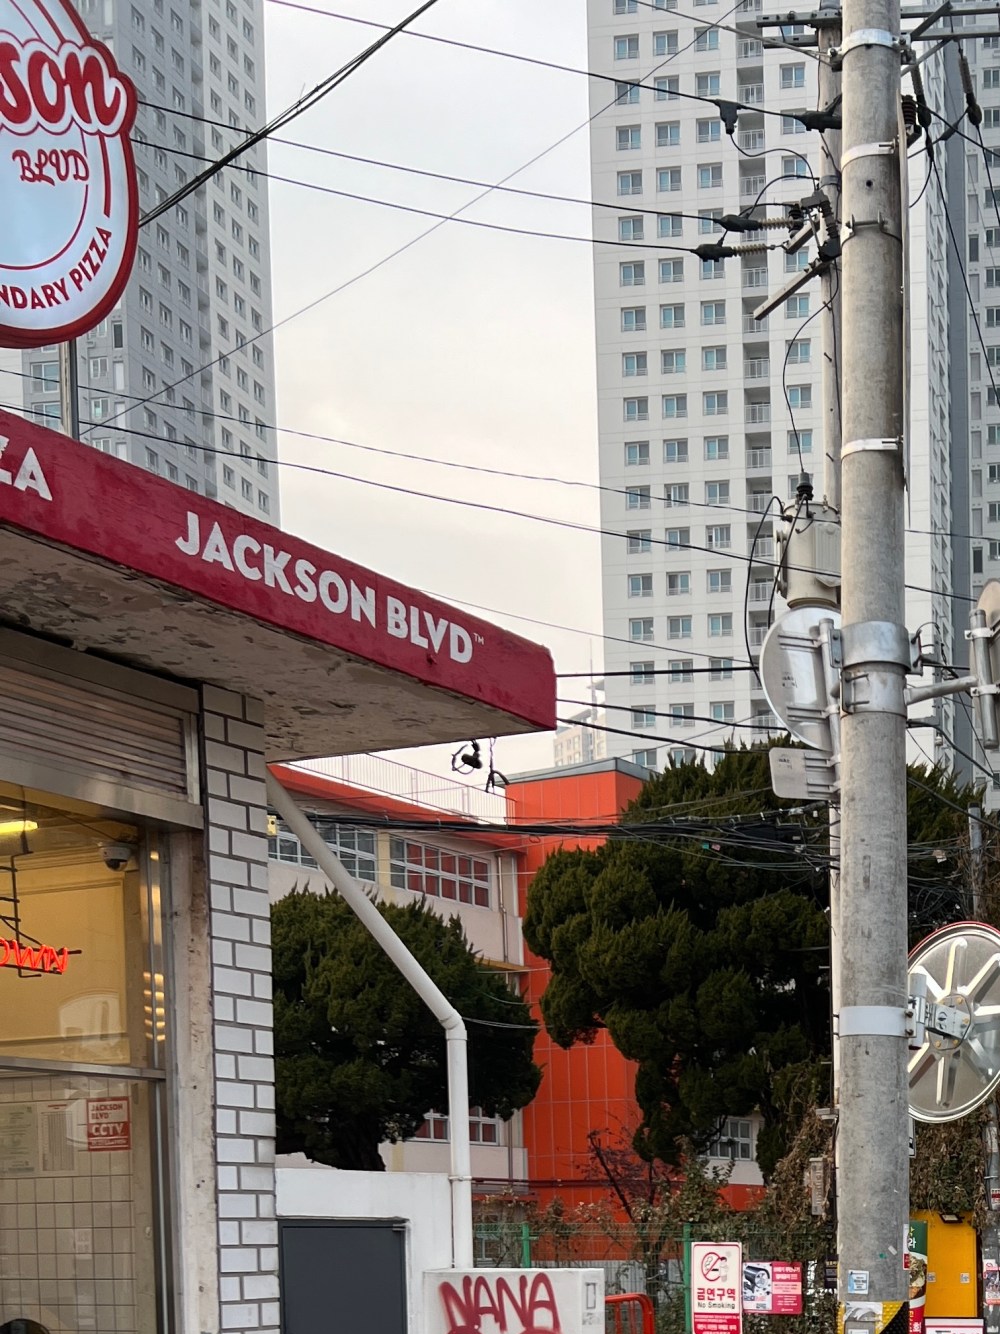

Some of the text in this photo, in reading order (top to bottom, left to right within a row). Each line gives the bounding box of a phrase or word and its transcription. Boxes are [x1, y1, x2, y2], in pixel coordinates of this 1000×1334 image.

[12, 148, 89, 186] BLVD
[69, 226, 112, 292] PIZZA
[174, 511, 376, 629] JACKSON
[90, 1103, 123, 1112] JACKSON
[92, 1123, 124, 1136] CCTV
[438, 1272, 562, 1334] NANA
[697, 1287, 736, 1301] 금연구역
[708, 1302, 736, 1310] Smoking
